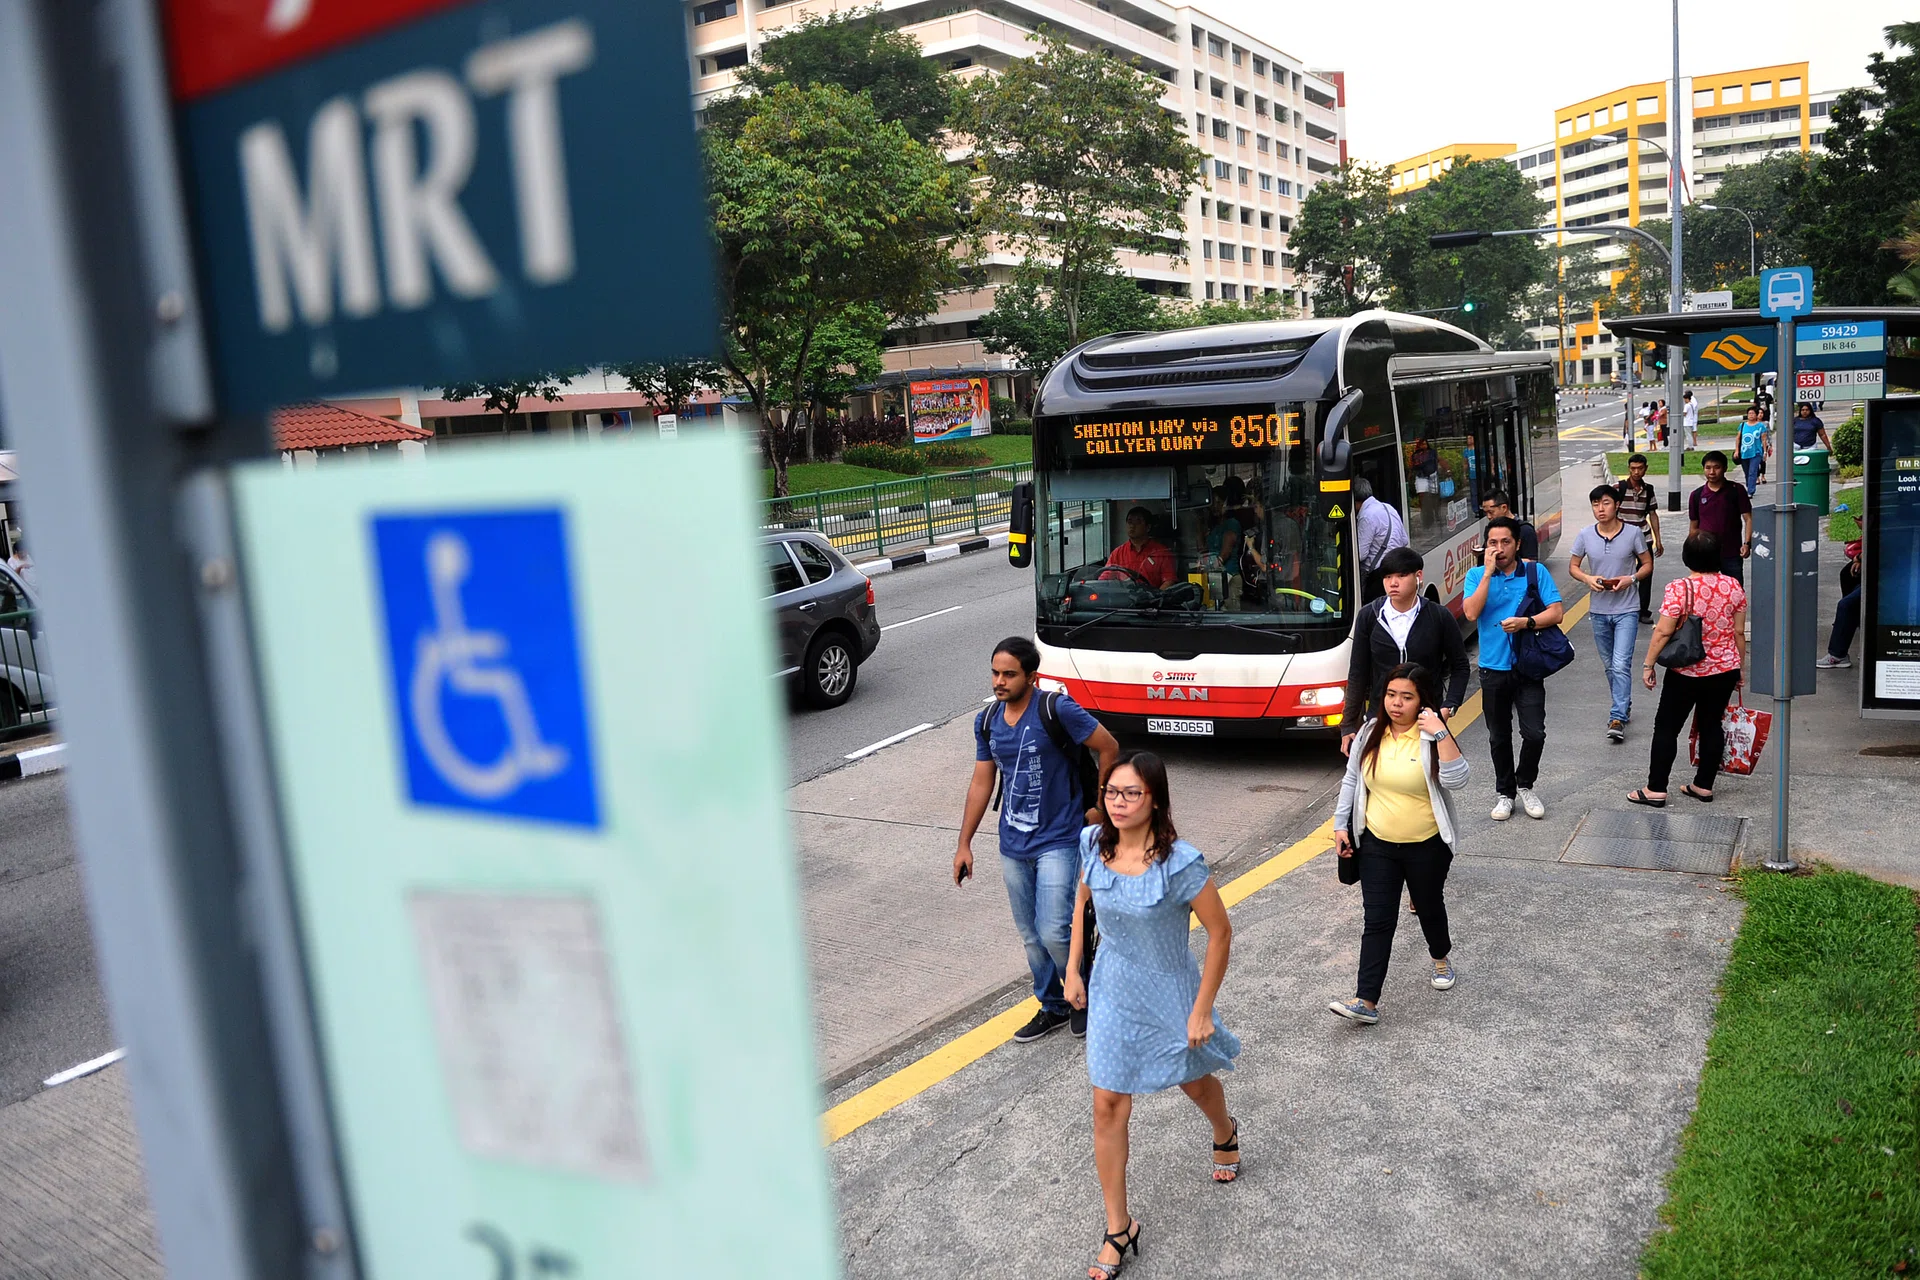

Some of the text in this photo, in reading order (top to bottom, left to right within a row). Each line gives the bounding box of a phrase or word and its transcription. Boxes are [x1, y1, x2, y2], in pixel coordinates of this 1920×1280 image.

[240, 18, 593, 333] MRT
[1821, 325, 1858, 337] 59429
[1822, 341, 1856, 350] Blk 846
[1800, 371, 1880, 386] 559 811 850E
[1800, 389, 1821, 400] 860
[1074, 417, 1218, 439] SHENTON WAY via
[1230, 412, 1300, 448] 850E
[1086, 435, 1205, 454] COLLYER QUAY
[1165, 672, 1197, 681] SMRT
[1147, 686, 1208, 701] MAN
[1149, 720, 1213, 733] SMB3065D
